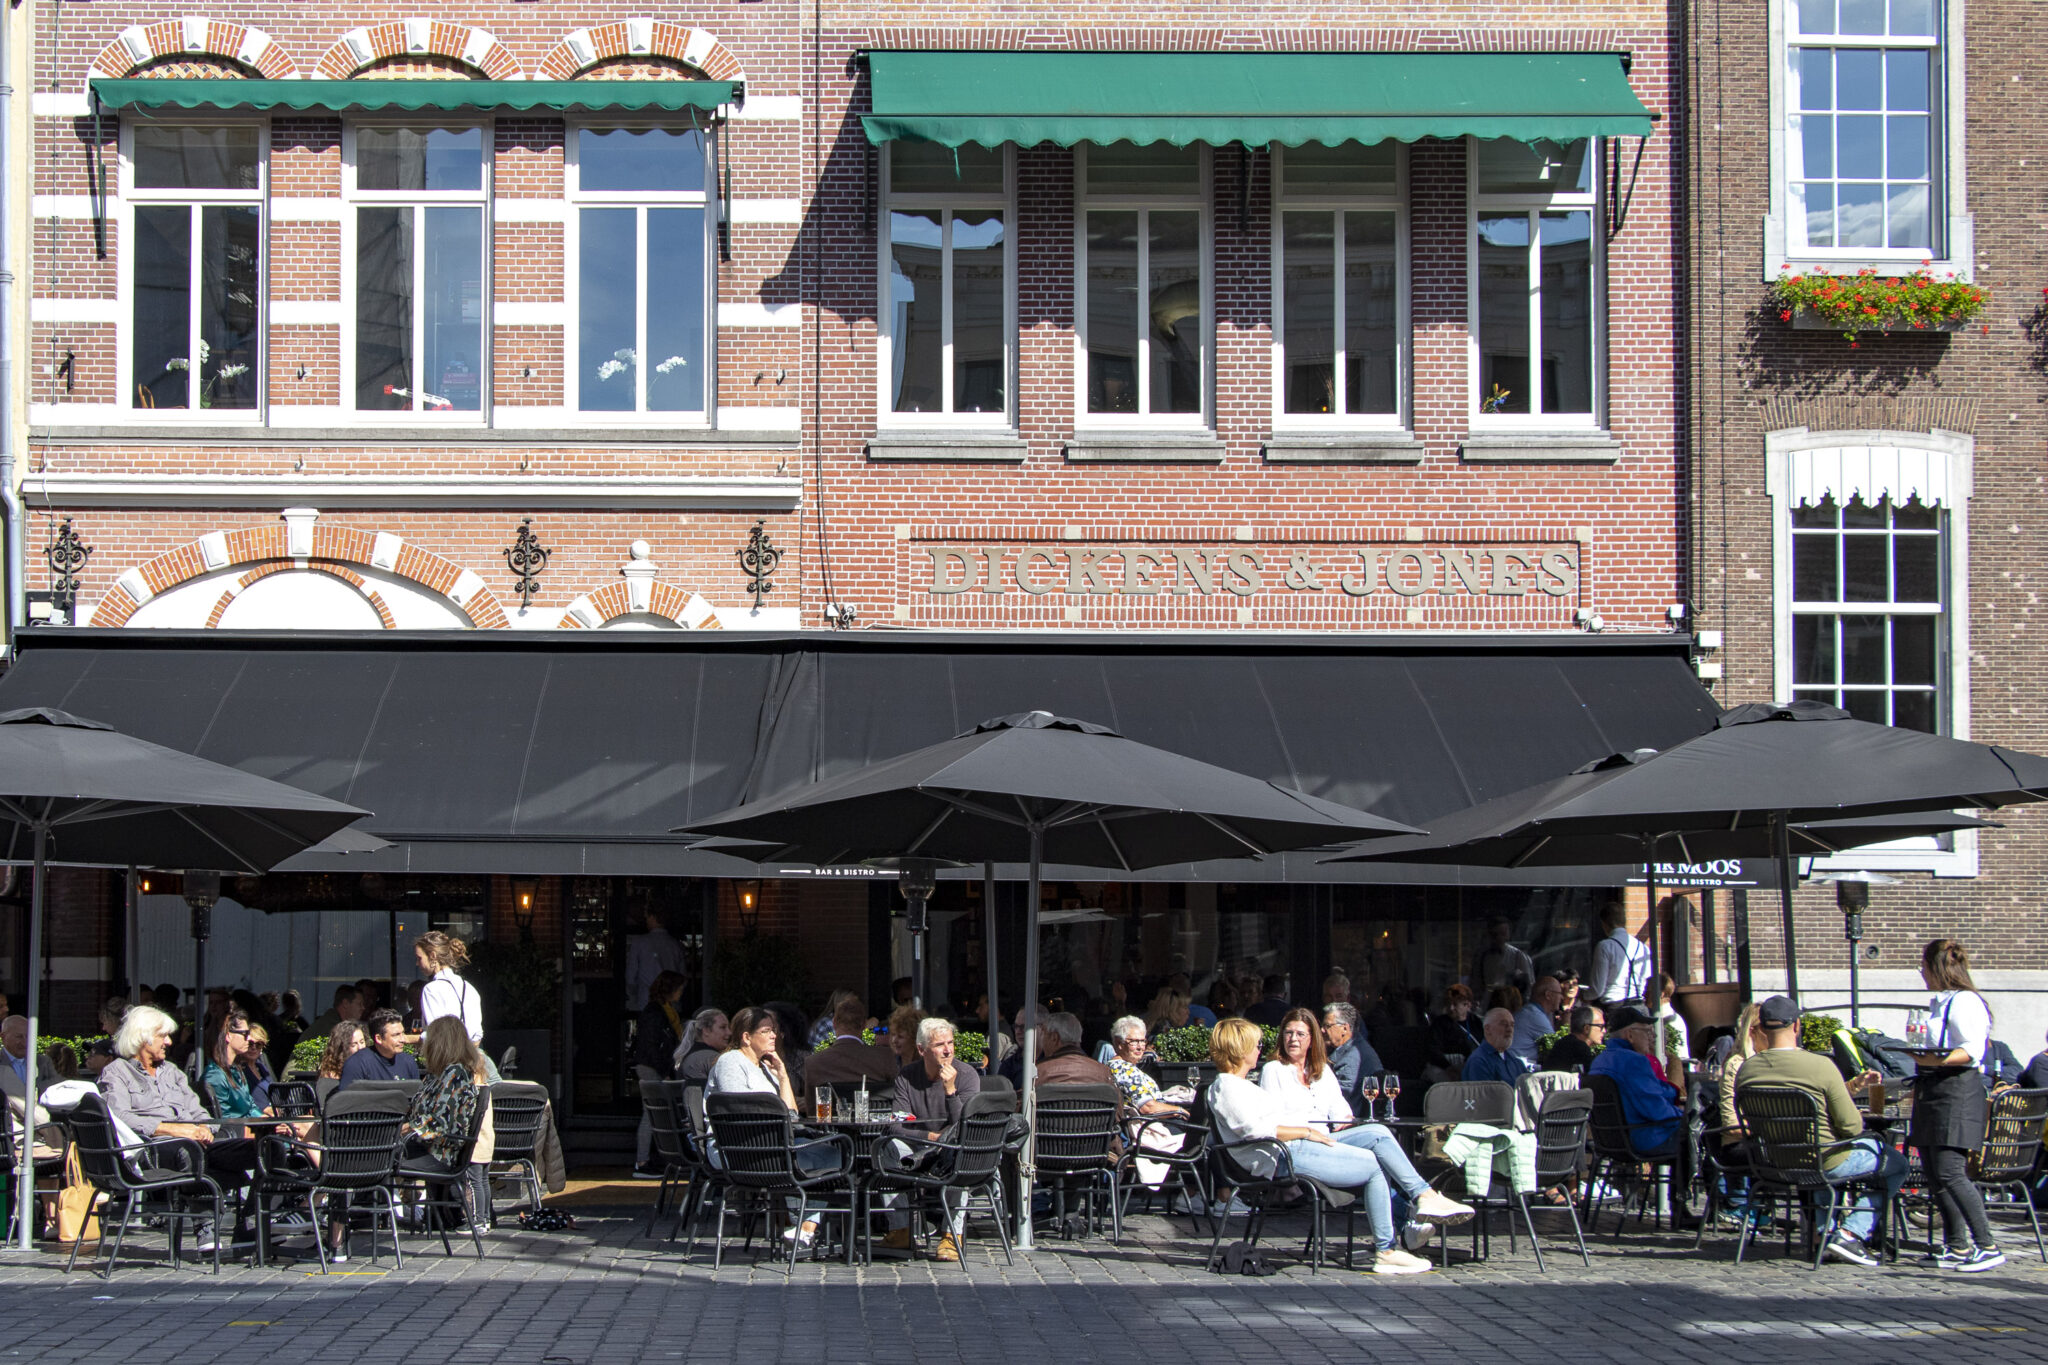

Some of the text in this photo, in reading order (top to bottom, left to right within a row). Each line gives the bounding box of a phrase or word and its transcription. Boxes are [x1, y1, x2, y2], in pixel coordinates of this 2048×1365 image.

[928, 548, 1577, 596] DICKENS & JONES
[815, 868, 875, 876] BAR & BISTRO
[1677, 859, 1742, 876] MOOS
[1690, 878, 1722, 886] BISTRO
